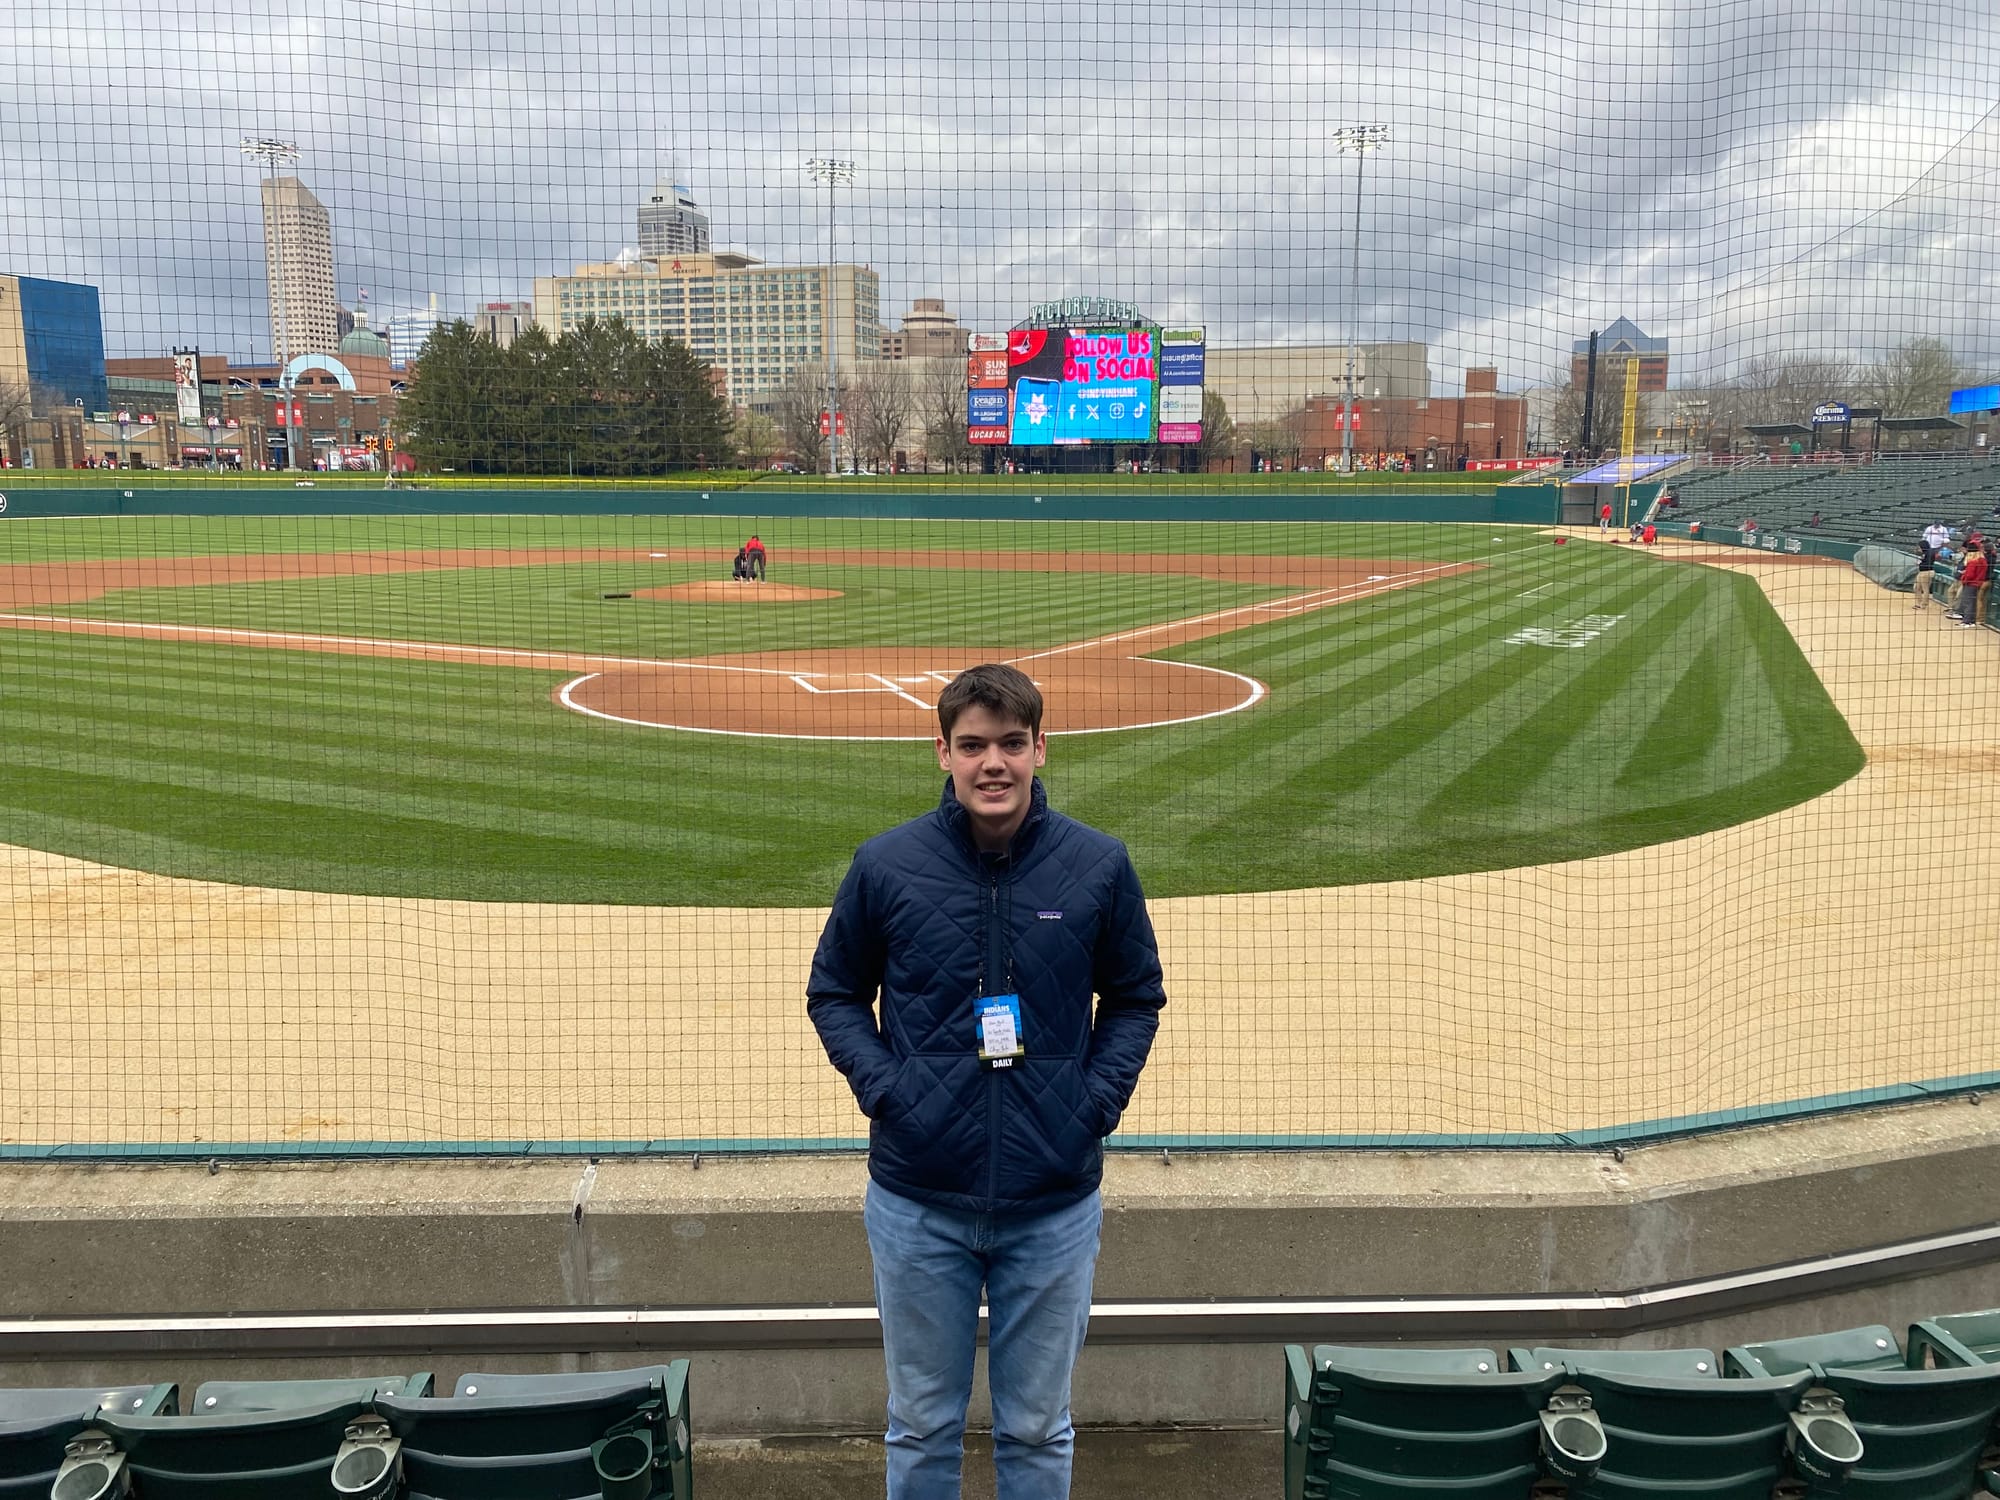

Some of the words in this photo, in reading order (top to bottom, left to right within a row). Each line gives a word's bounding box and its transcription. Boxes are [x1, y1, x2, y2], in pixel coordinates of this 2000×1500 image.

[1032, 297, 1090, 324] VICTORY
[1097, 297, 1139, 321] FIELD
[1064, 338, 1122, 357] FOLLOW
[1127, 331, 1150, 355] US
[985, 360, 1007, 369] SUN
[1063, 357, 1090, 383] ON
[1096, 357, 1158, 380] SOCIAL
[970, 431, 993, 439] LUCAS
[994, 431, 1006, 439] OIL
[992, 1058, 1013, 1068] DAILY
